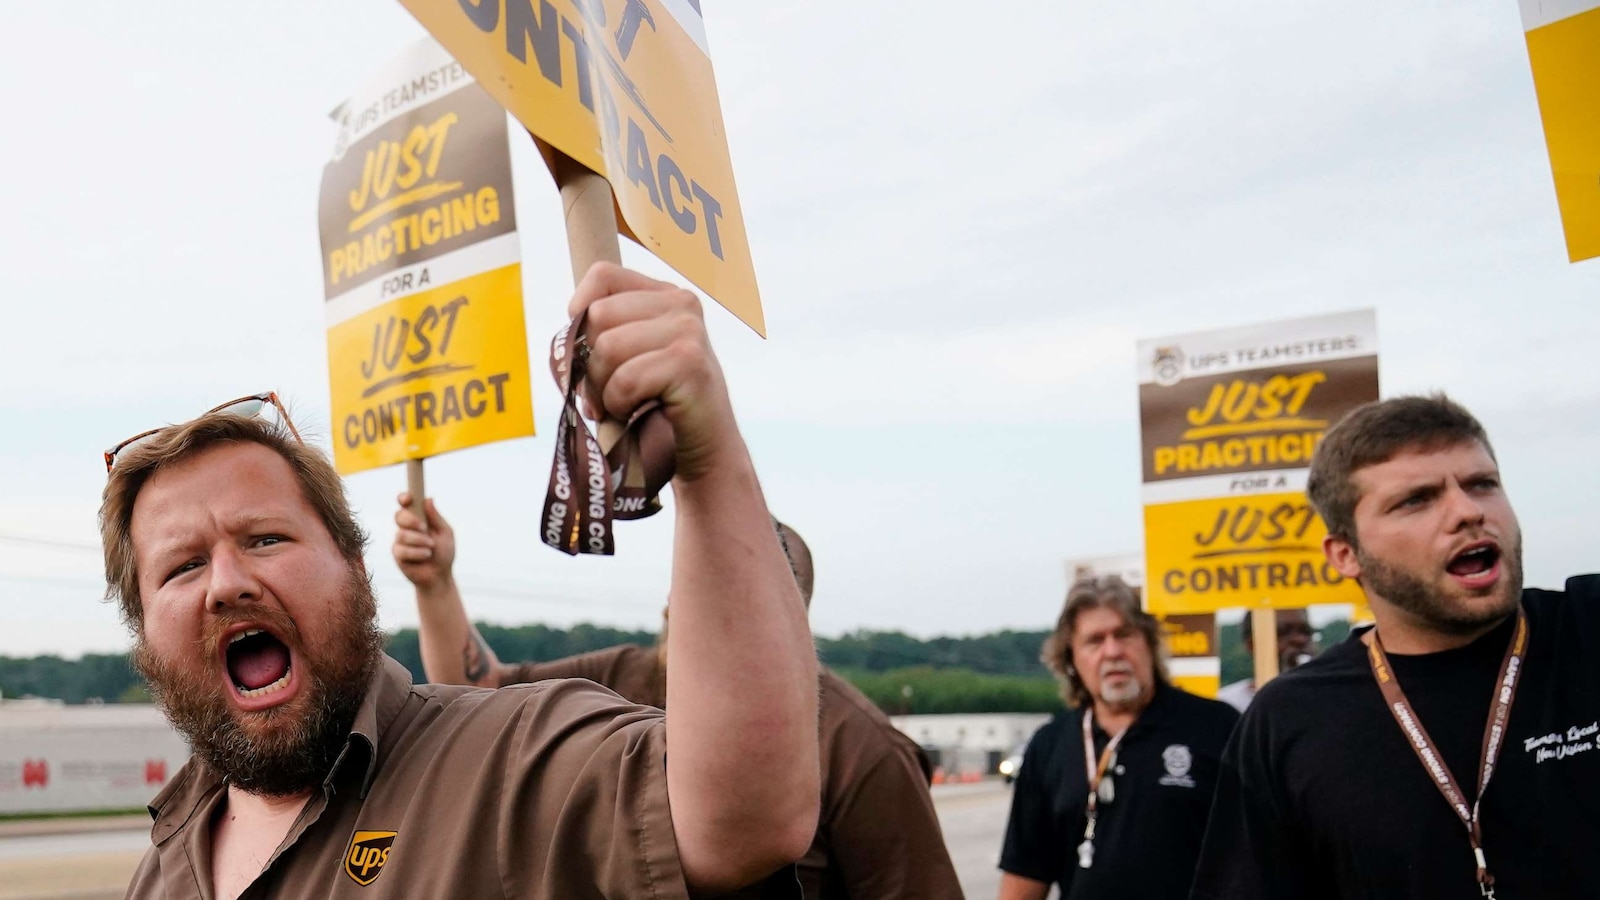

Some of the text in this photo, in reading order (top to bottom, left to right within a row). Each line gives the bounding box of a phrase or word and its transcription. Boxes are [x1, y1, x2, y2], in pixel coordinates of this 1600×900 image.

[382, 61, 468, 115] TEAMSTE
[349, 112, 458, 212] JUST
[330, 187, 500, 285] PRACTICING
[381, 268, 430, 297] FOR A
[361, 296, 469, 379] JUST
[1190, 335, 1358, 370] UPS TEAMSTERS
[344, 373, 509, 449] CONTRACT
[1187, 371, 1327, 426] JUST
[586, 438, 605, 518] STRONG
[1274, 476, 1287, 488] A
[1194, 502, 1317, 546] JUST
[1499, 686, 1511, 704] ON
[1421, 748, 1449, 784] STRONG
[350, 845, 391, 876] ups
